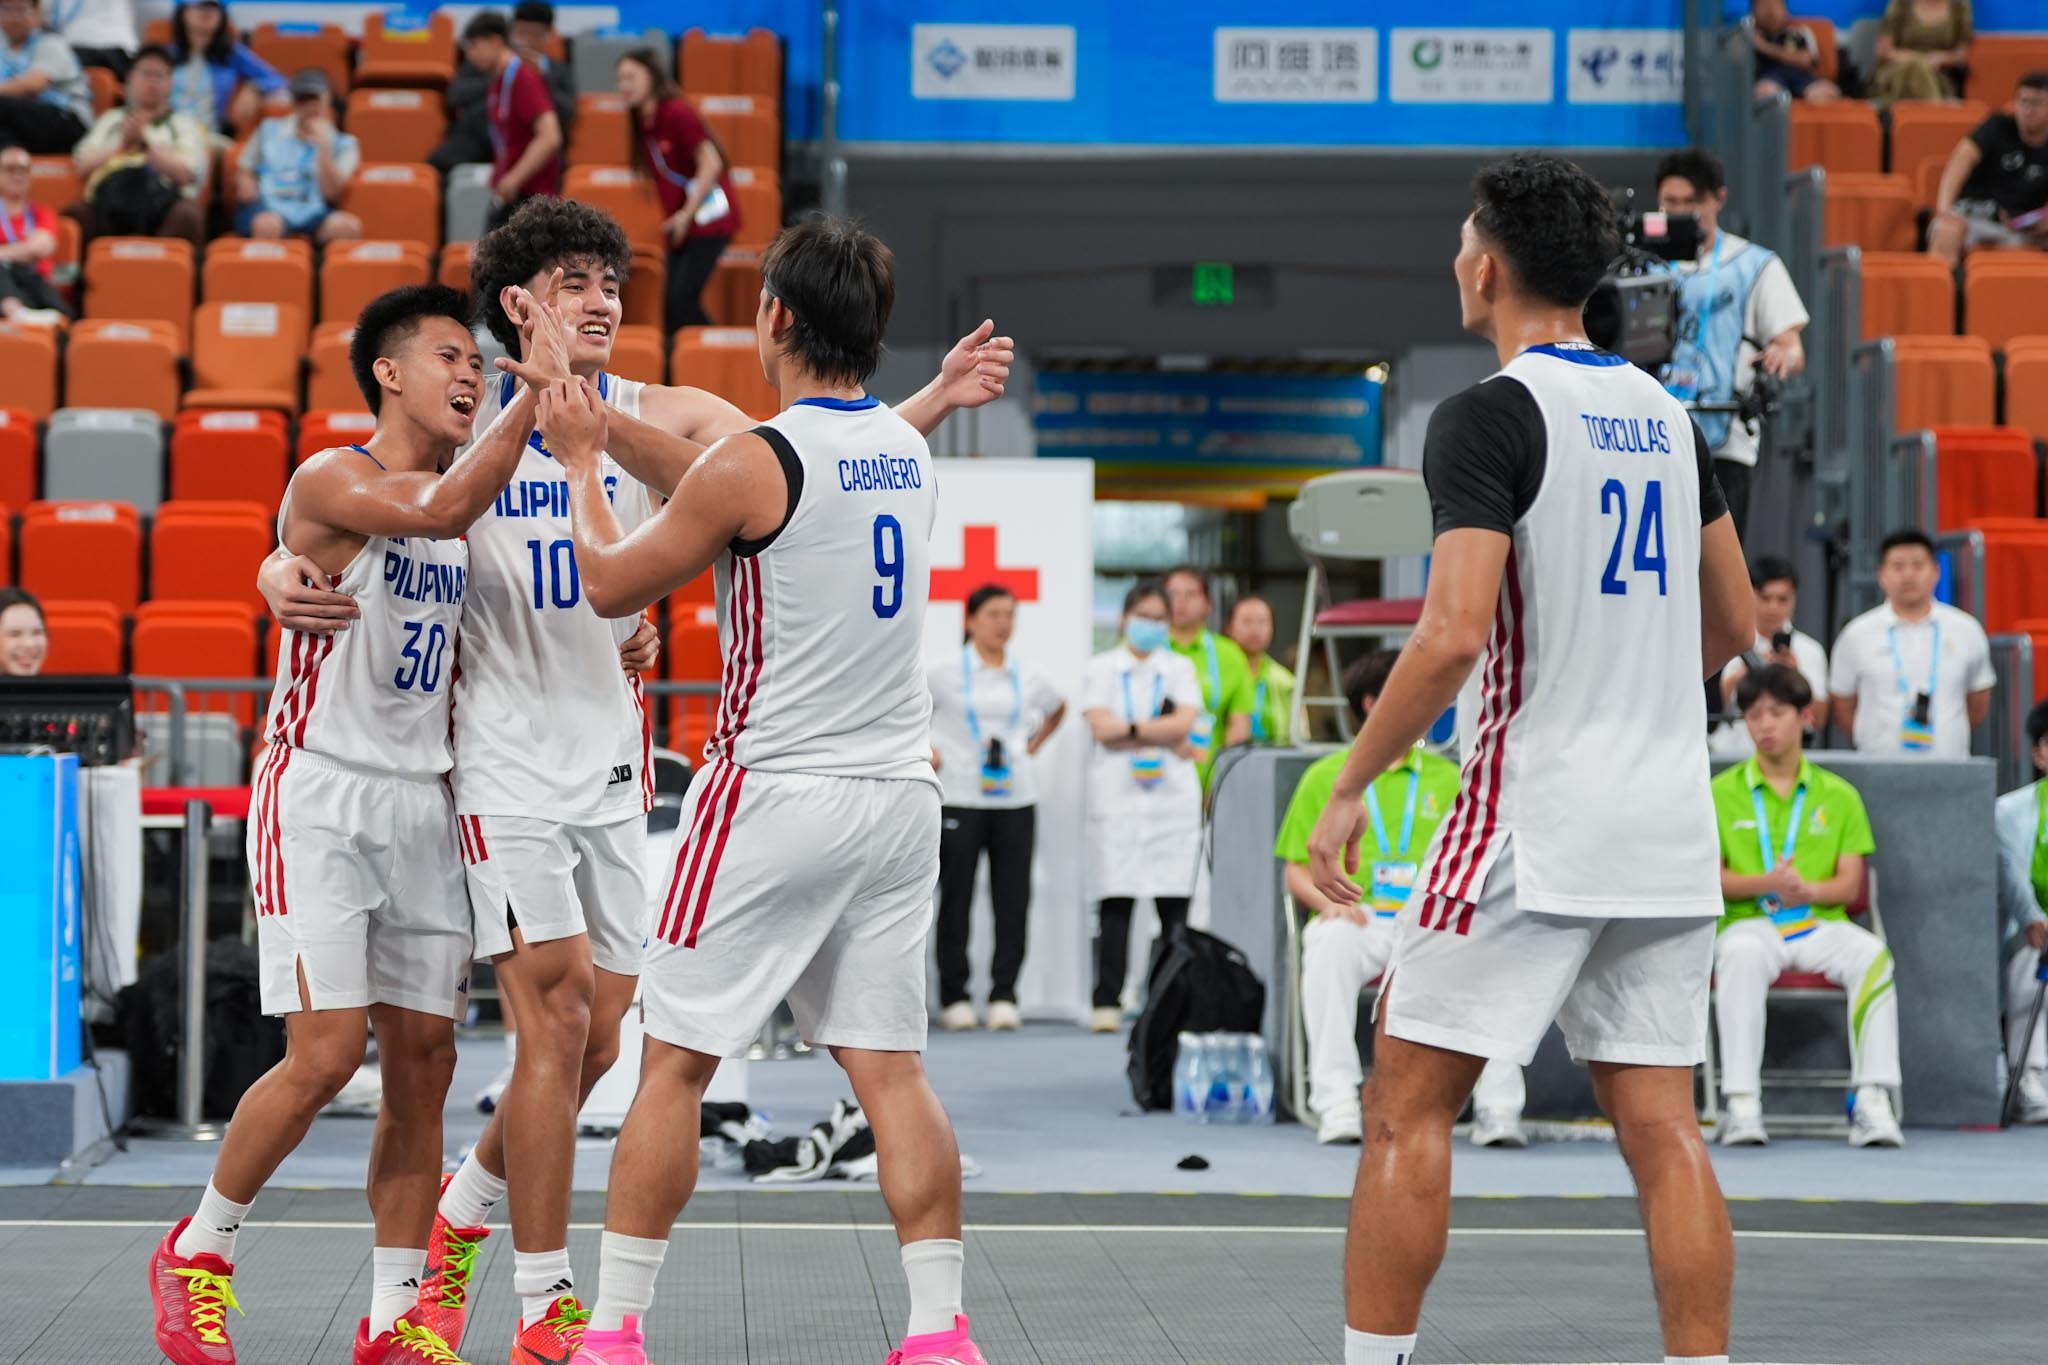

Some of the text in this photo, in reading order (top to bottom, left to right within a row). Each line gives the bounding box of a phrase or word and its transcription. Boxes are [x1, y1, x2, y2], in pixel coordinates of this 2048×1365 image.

[1581, 414, 1670, 454] TORCULAS
[838, 453, 921, 492] CABAÑERO
[873, 514, 904, 618] 9
[1601, 479, 1666, 596] 24
[384, 550, 466, 606] PILIPINA
[527, 539, 580, 609] 10
[395, 621, 446, 692] 30
